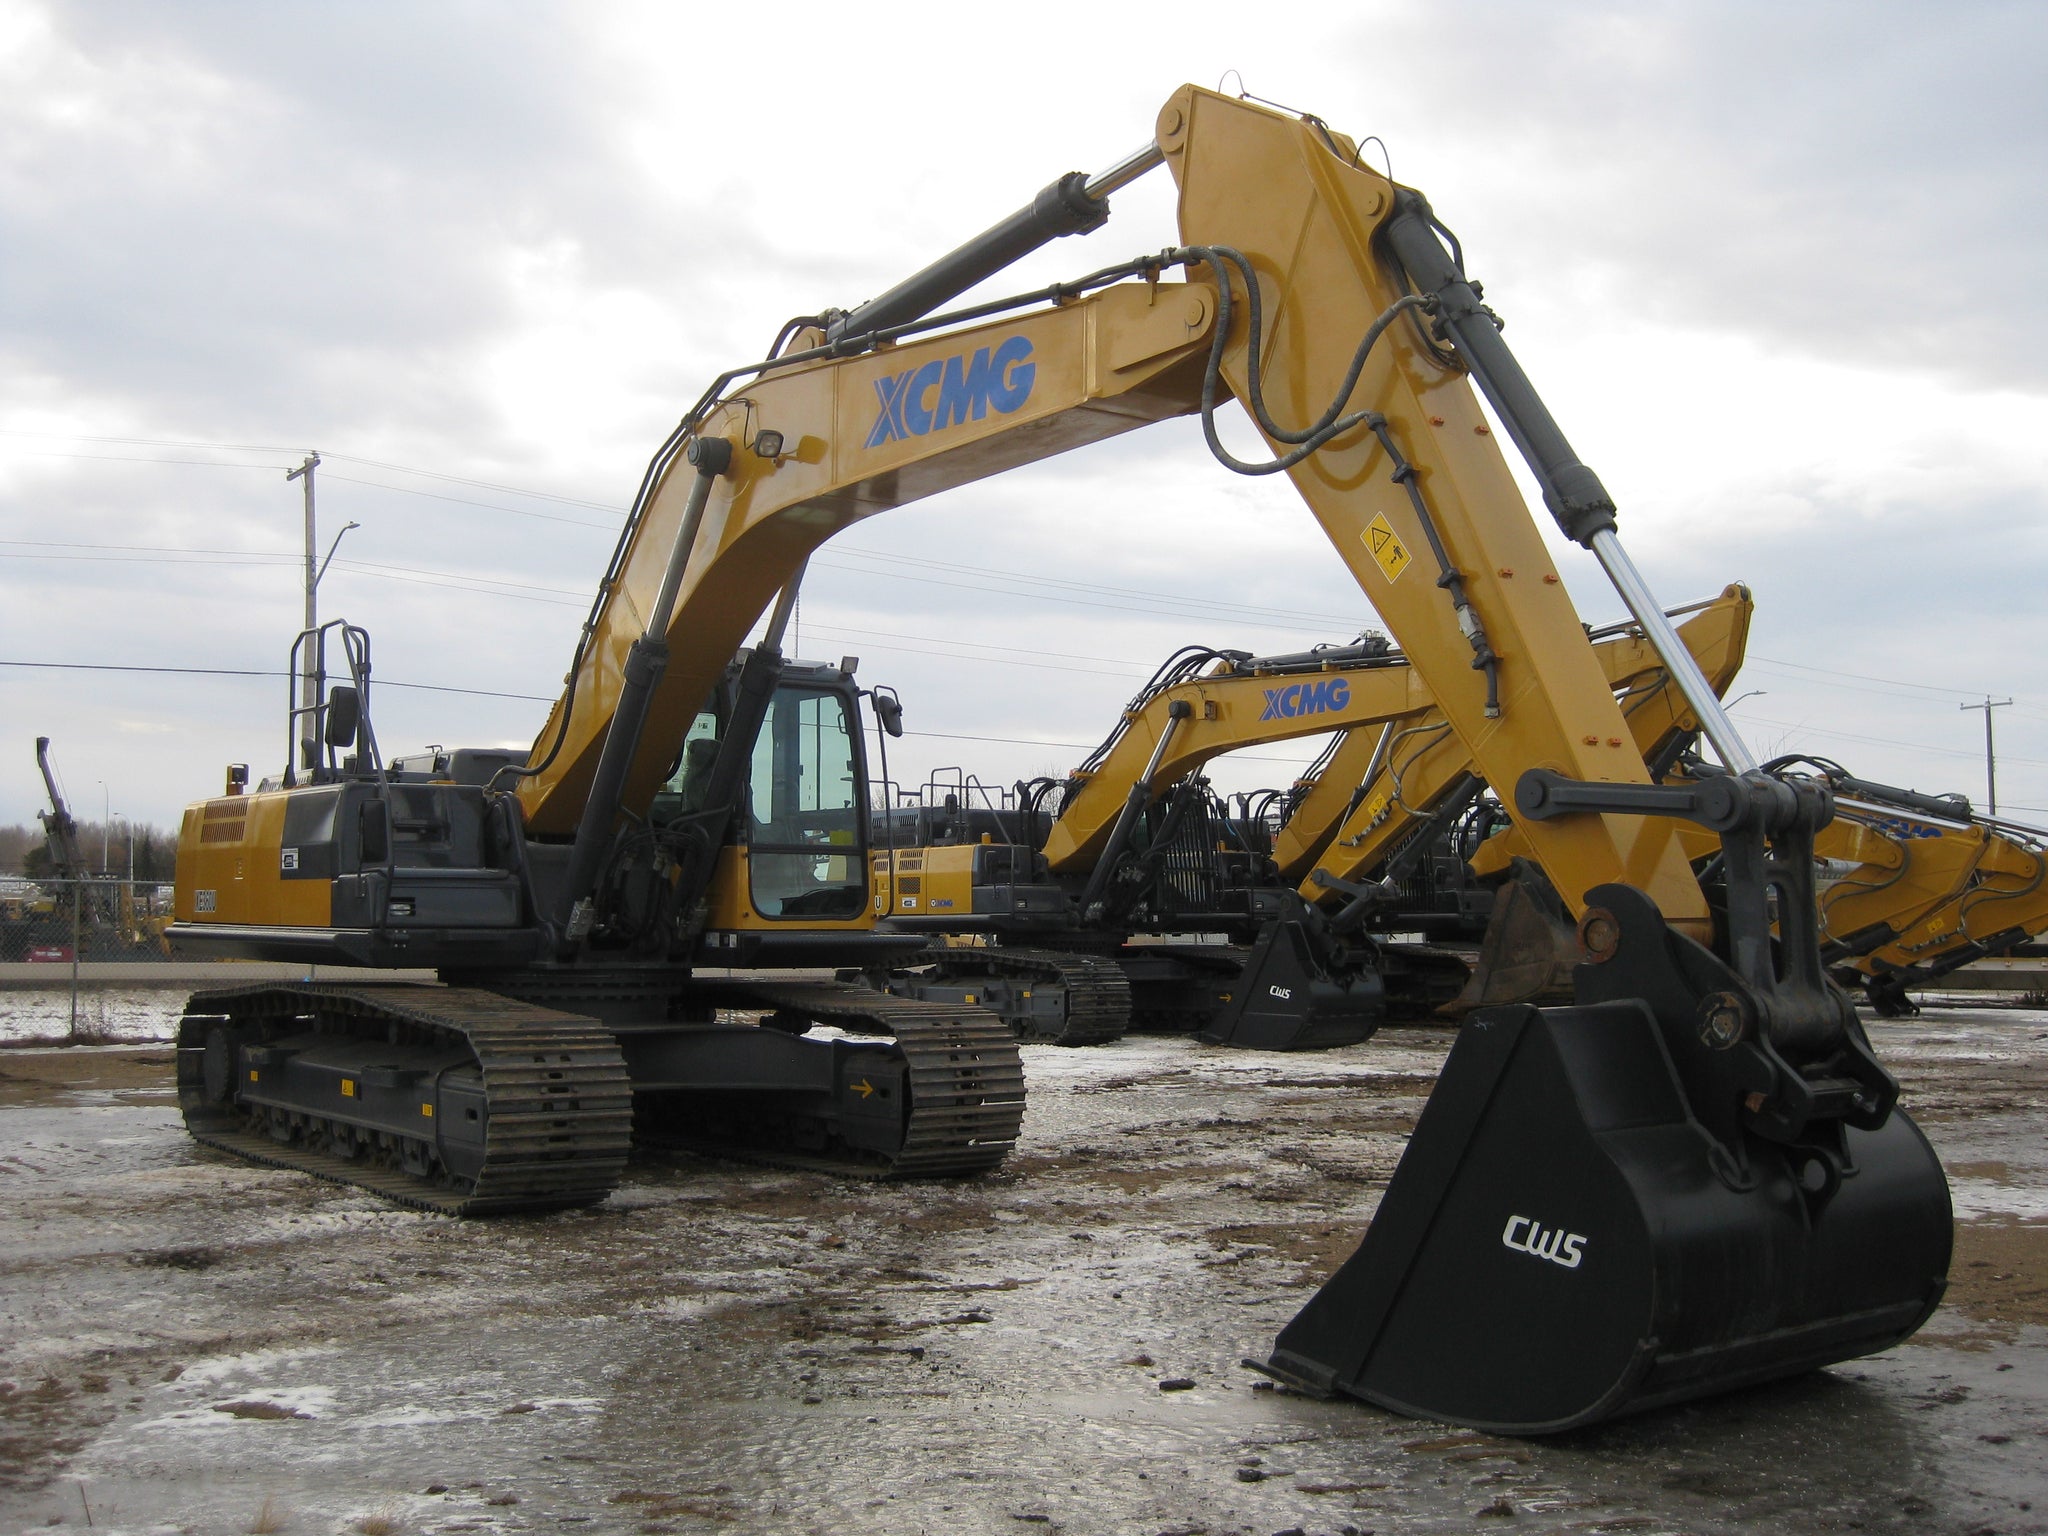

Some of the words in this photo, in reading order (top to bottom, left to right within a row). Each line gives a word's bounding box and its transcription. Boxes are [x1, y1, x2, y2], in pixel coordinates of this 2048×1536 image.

[864, 336, 1036, 448] XCMG
[1259, 678, 1350, 720] XCMG
[1270, 985, 1291, 998] CWS
[1503, 1215, 1587, 1267] CWS
